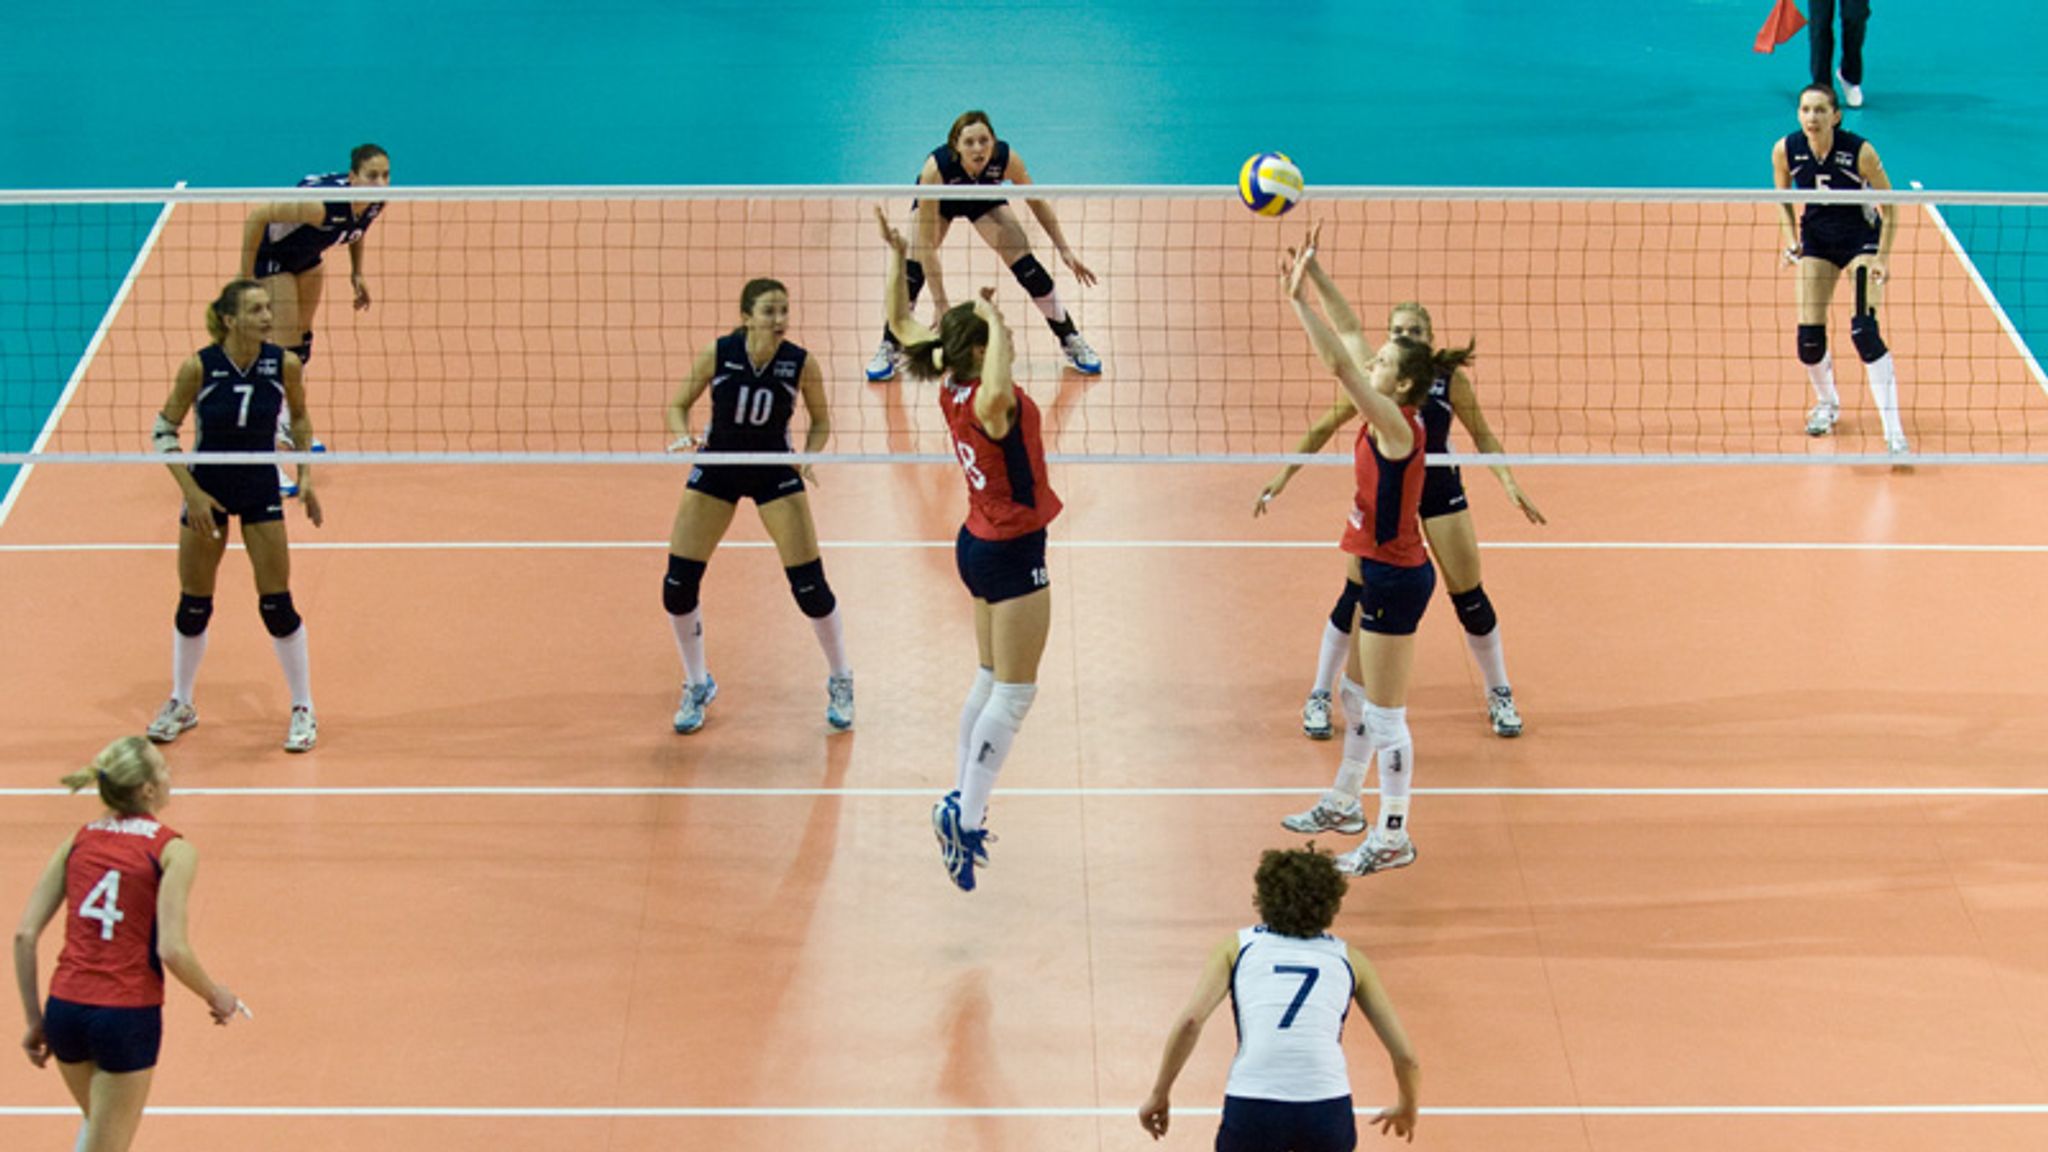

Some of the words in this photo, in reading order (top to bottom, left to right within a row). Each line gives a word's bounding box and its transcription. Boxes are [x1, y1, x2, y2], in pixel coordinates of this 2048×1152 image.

[233, 384, 255, 427] 7
[733, 385, 774, 426] 10
[78, 869, 125, 941] 4
[1272, 964, 1320, 1030] 7
